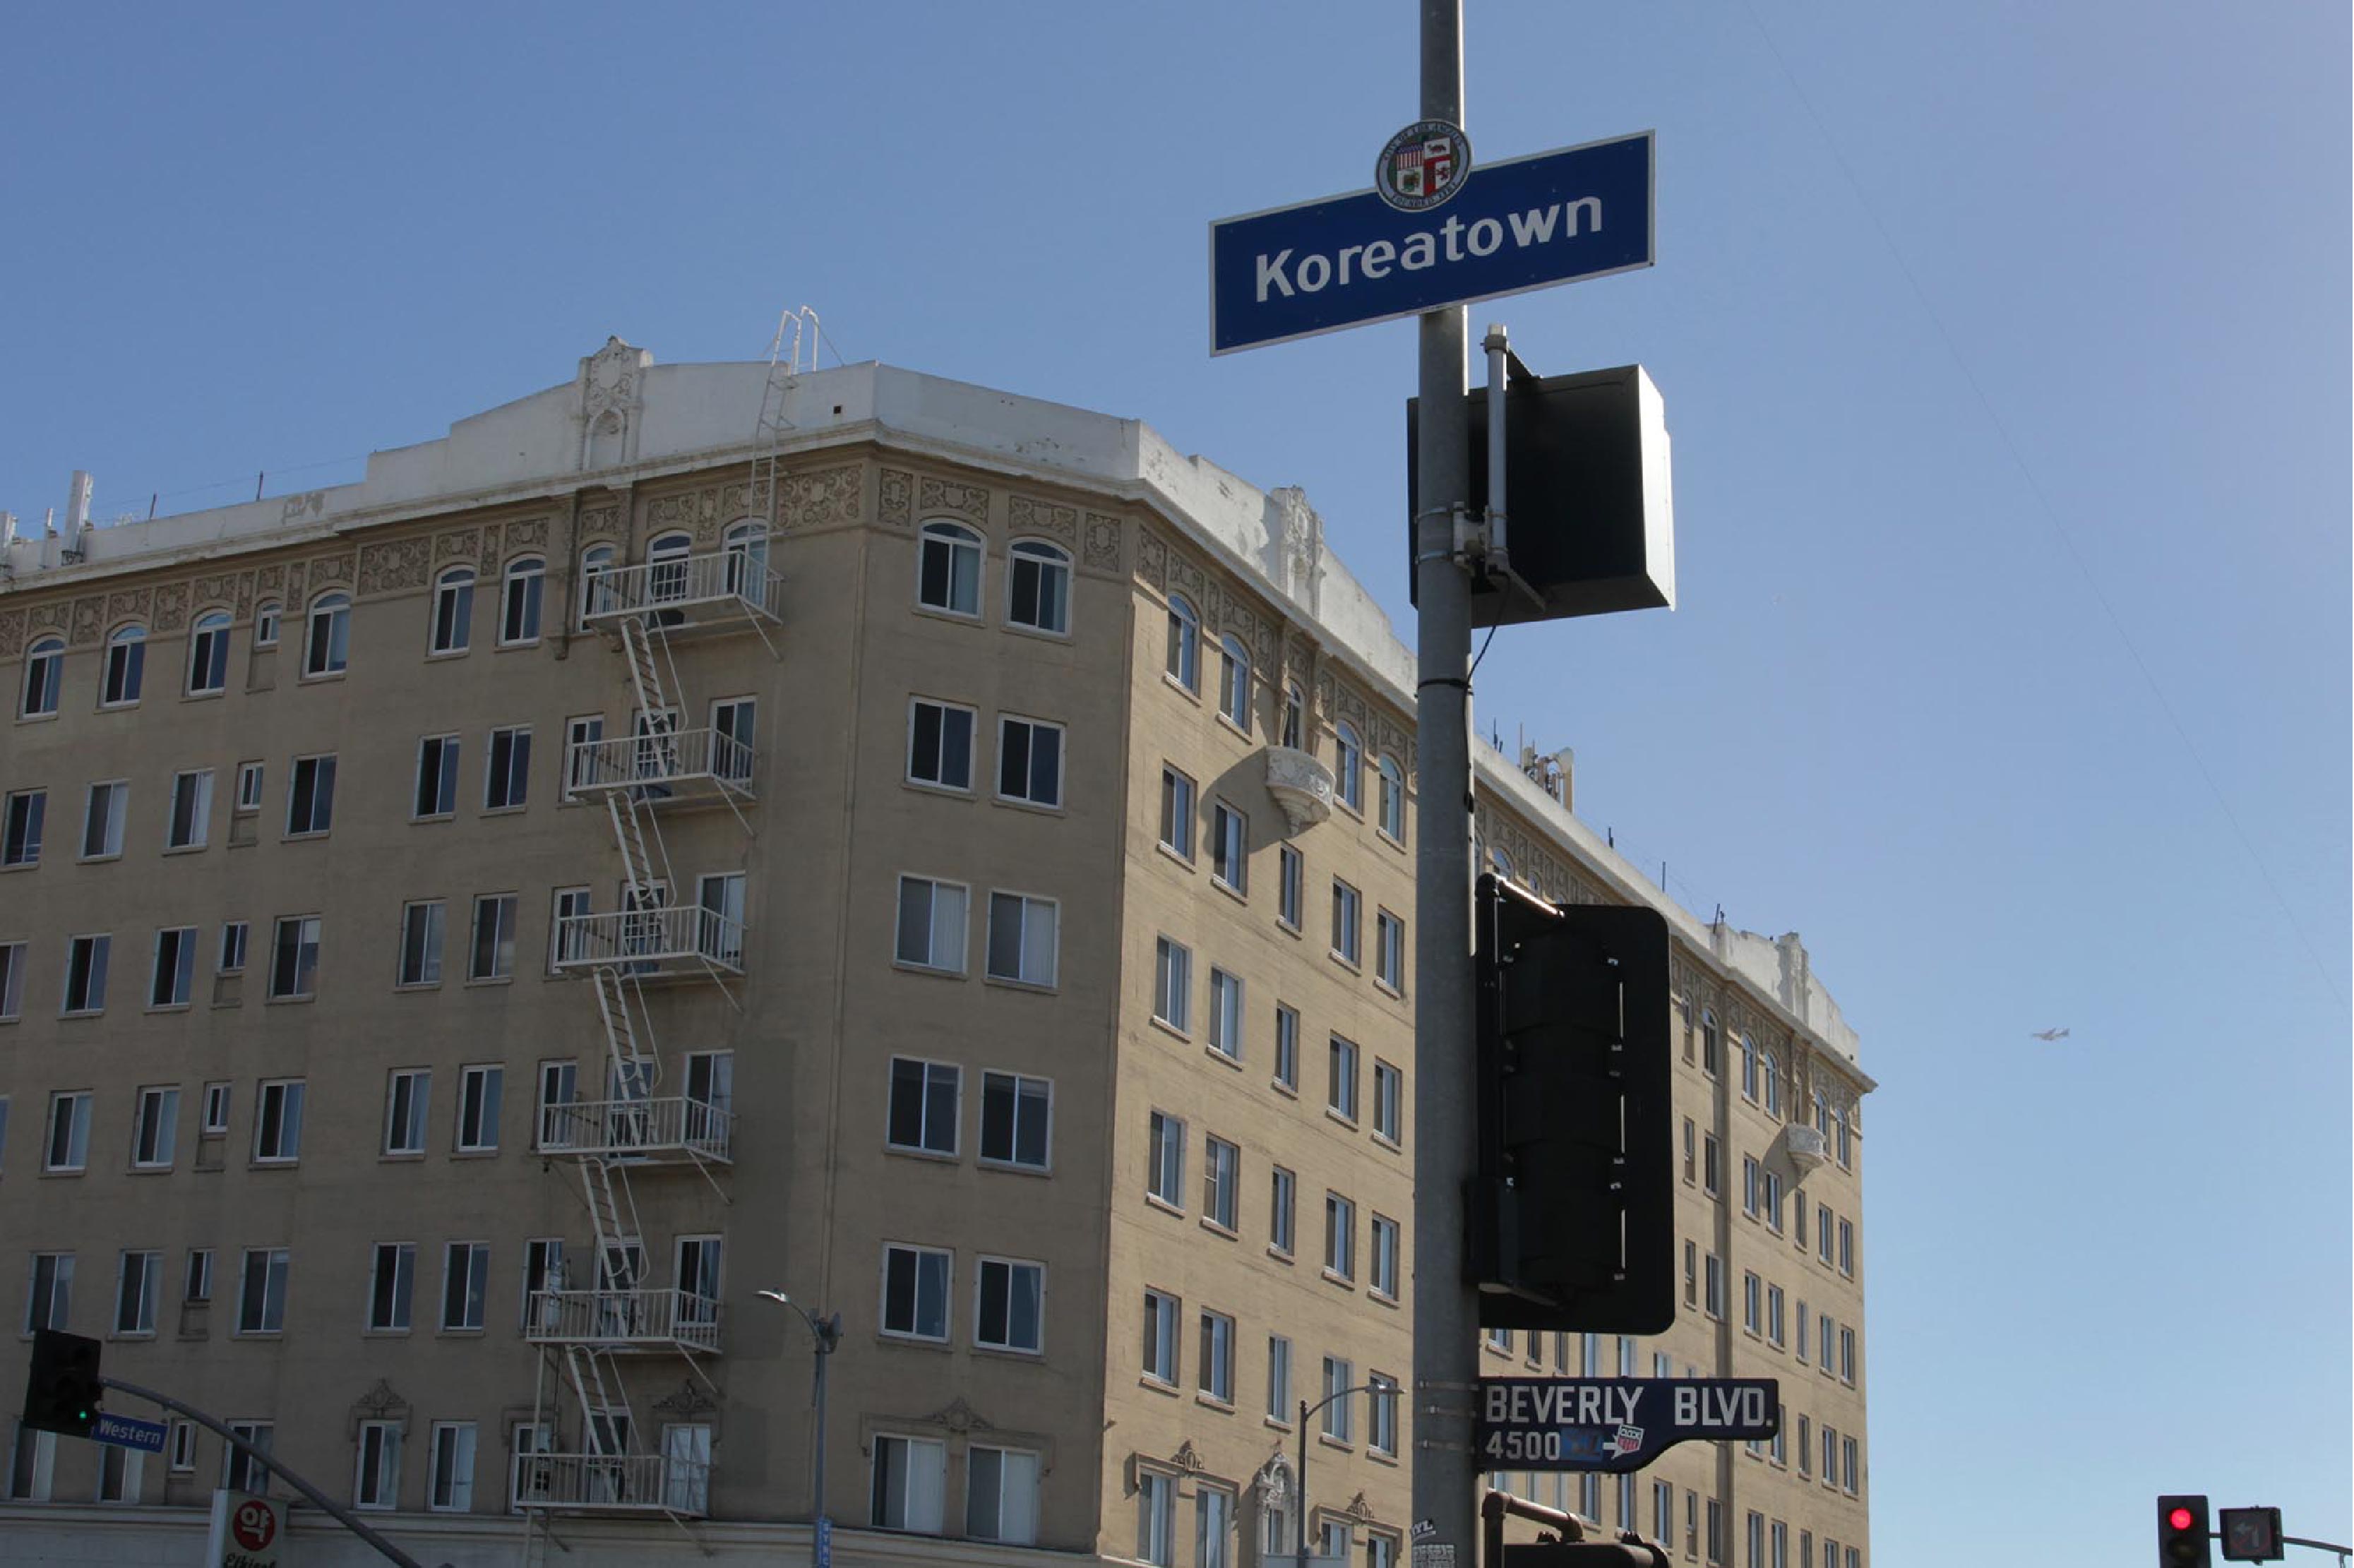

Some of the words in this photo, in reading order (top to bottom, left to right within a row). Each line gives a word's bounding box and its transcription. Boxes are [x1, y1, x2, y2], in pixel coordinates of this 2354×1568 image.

[1256, 195, 1601, 302] Koreatown
[1486, 1386, 1644, 1425] BEVERLY
[1674, 1387, 1774, 1427] BLVD.
[100, 1418, 161, 1445] Western
[1486, 1431, 1560, 1461] 4500
[241, 1507, 270, 1543] 약
